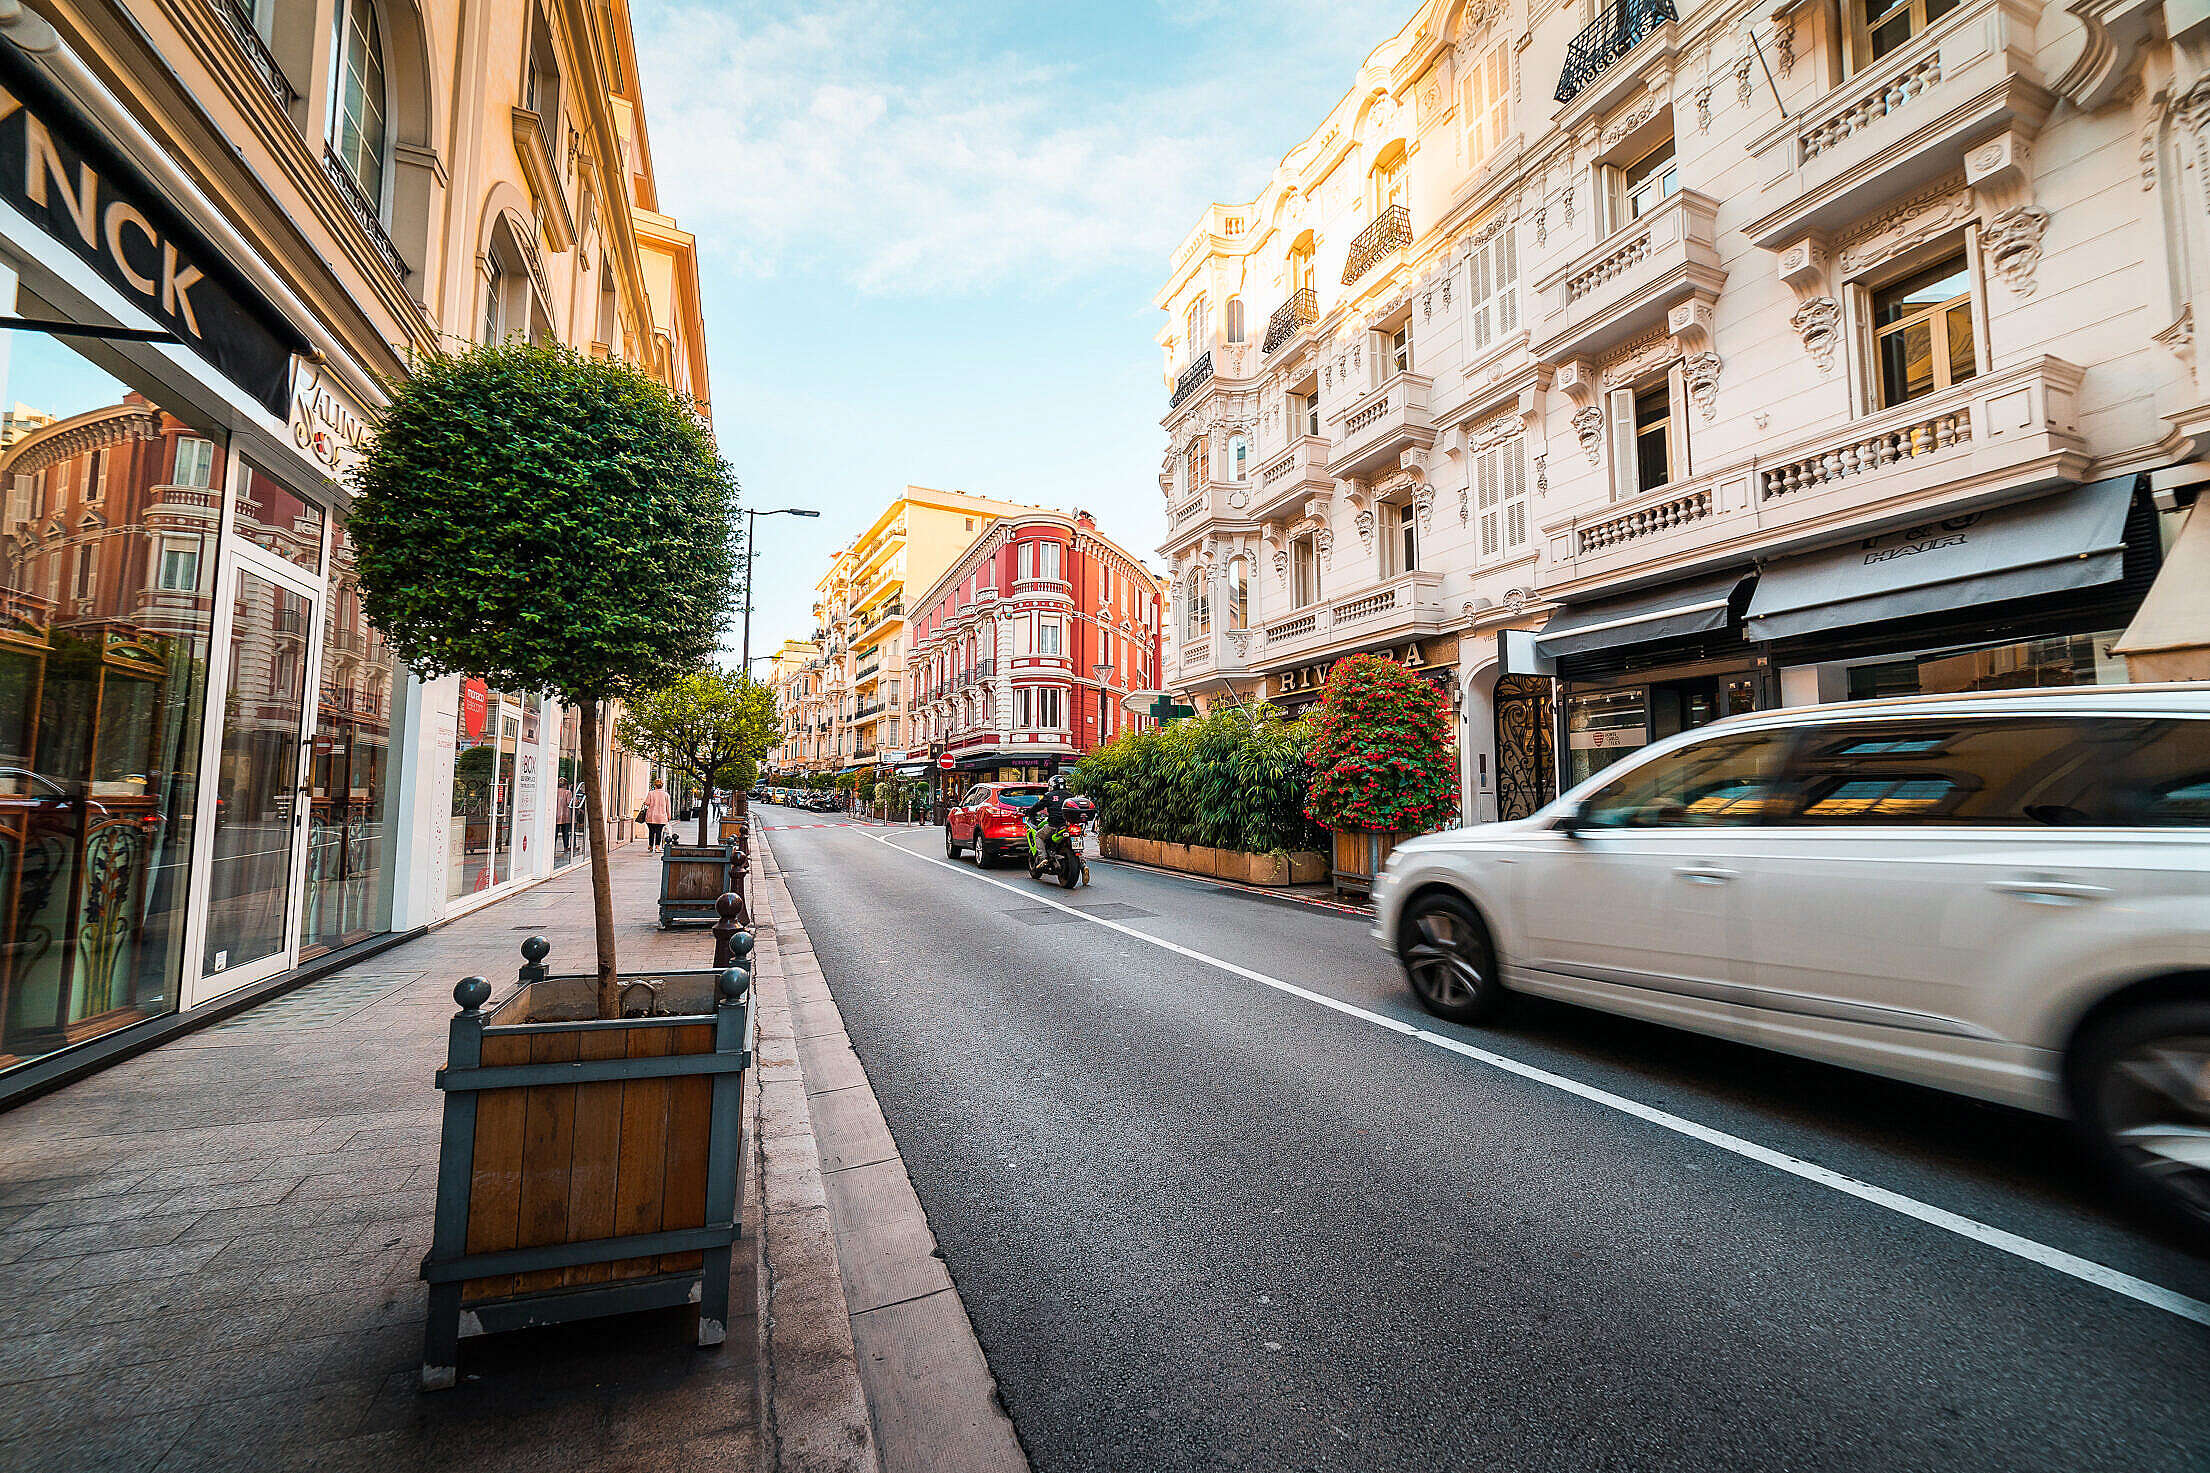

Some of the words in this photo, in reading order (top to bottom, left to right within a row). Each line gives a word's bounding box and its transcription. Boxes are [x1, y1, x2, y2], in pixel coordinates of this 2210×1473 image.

[0, 87, 204, 339] NCK
[1863, 533, 1968, 565] HAIR
[1279, 642, 1425, 692] RIVRA
[467, 688, 485, 703] monaco
